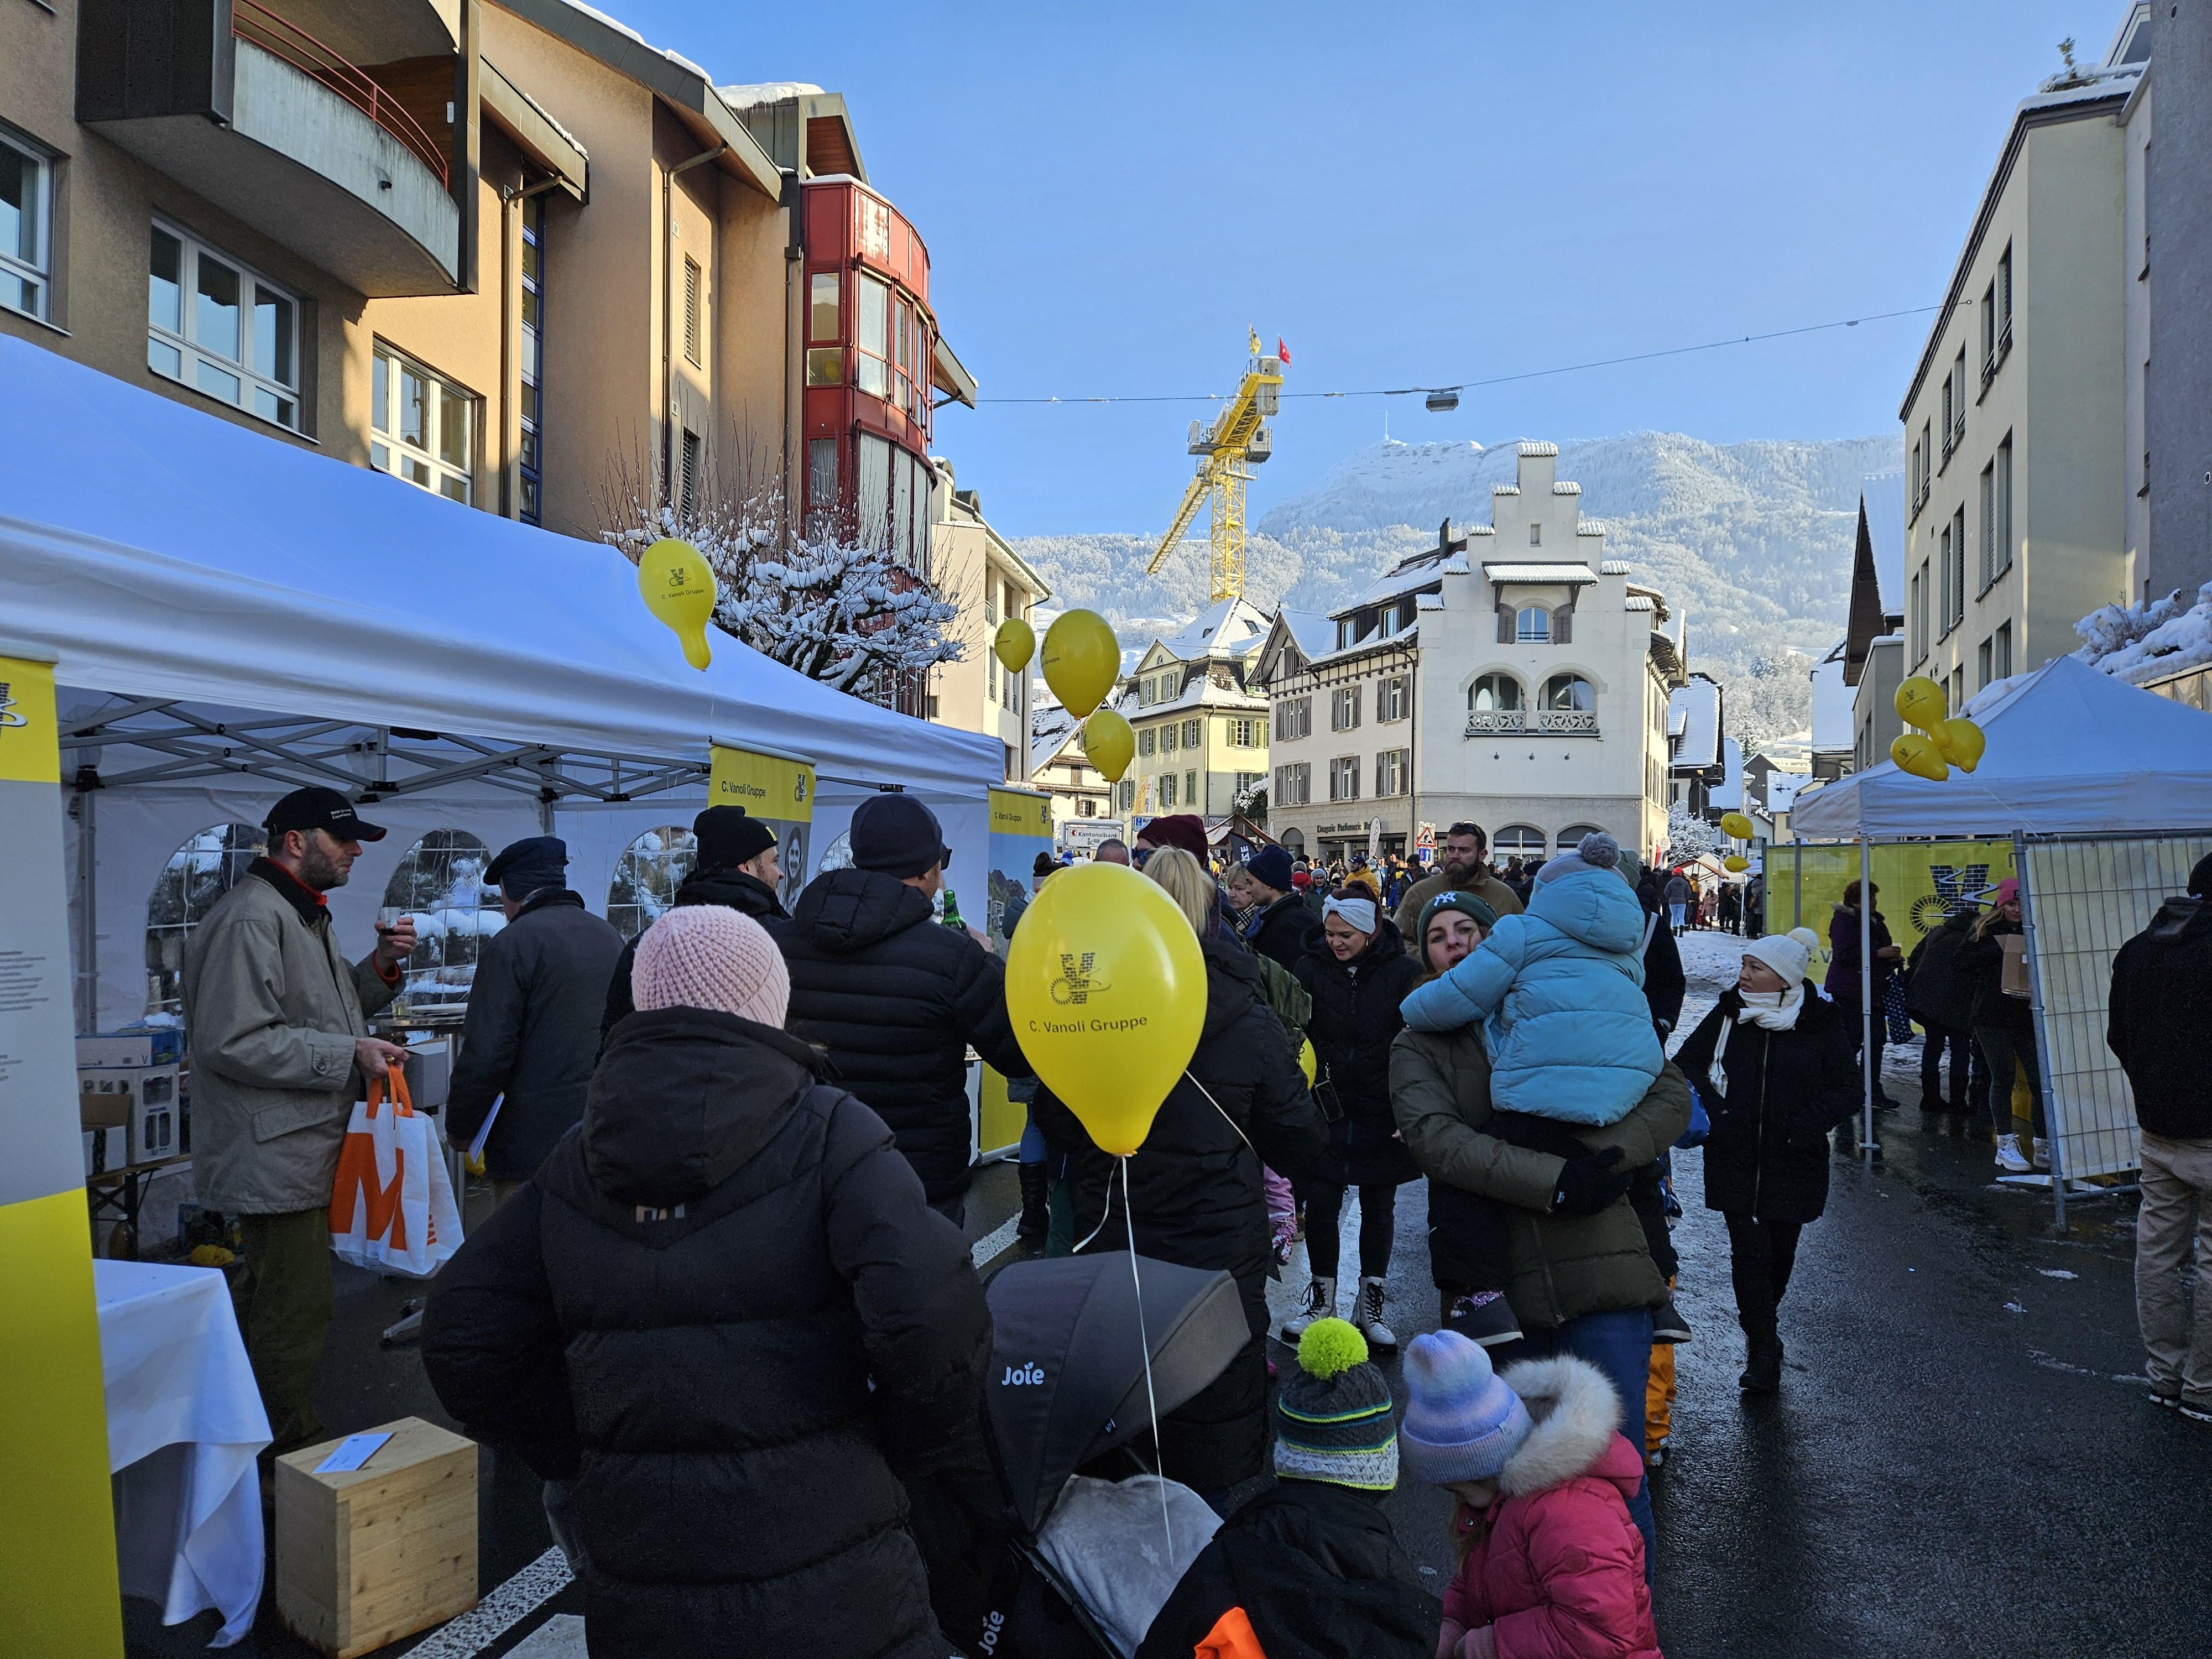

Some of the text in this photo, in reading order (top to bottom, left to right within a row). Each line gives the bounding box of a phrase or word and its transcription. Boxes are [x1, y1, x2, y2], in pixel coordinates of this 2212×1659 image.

[722, 780, 766, 799] C. Vanoli Gruppe
[1029, 1016, 1148, 1034] C. Vanoli Gruppe
[1001, 1361, 1045, 1386] Joie
[978, 1610, 1005, 1656] Joie
